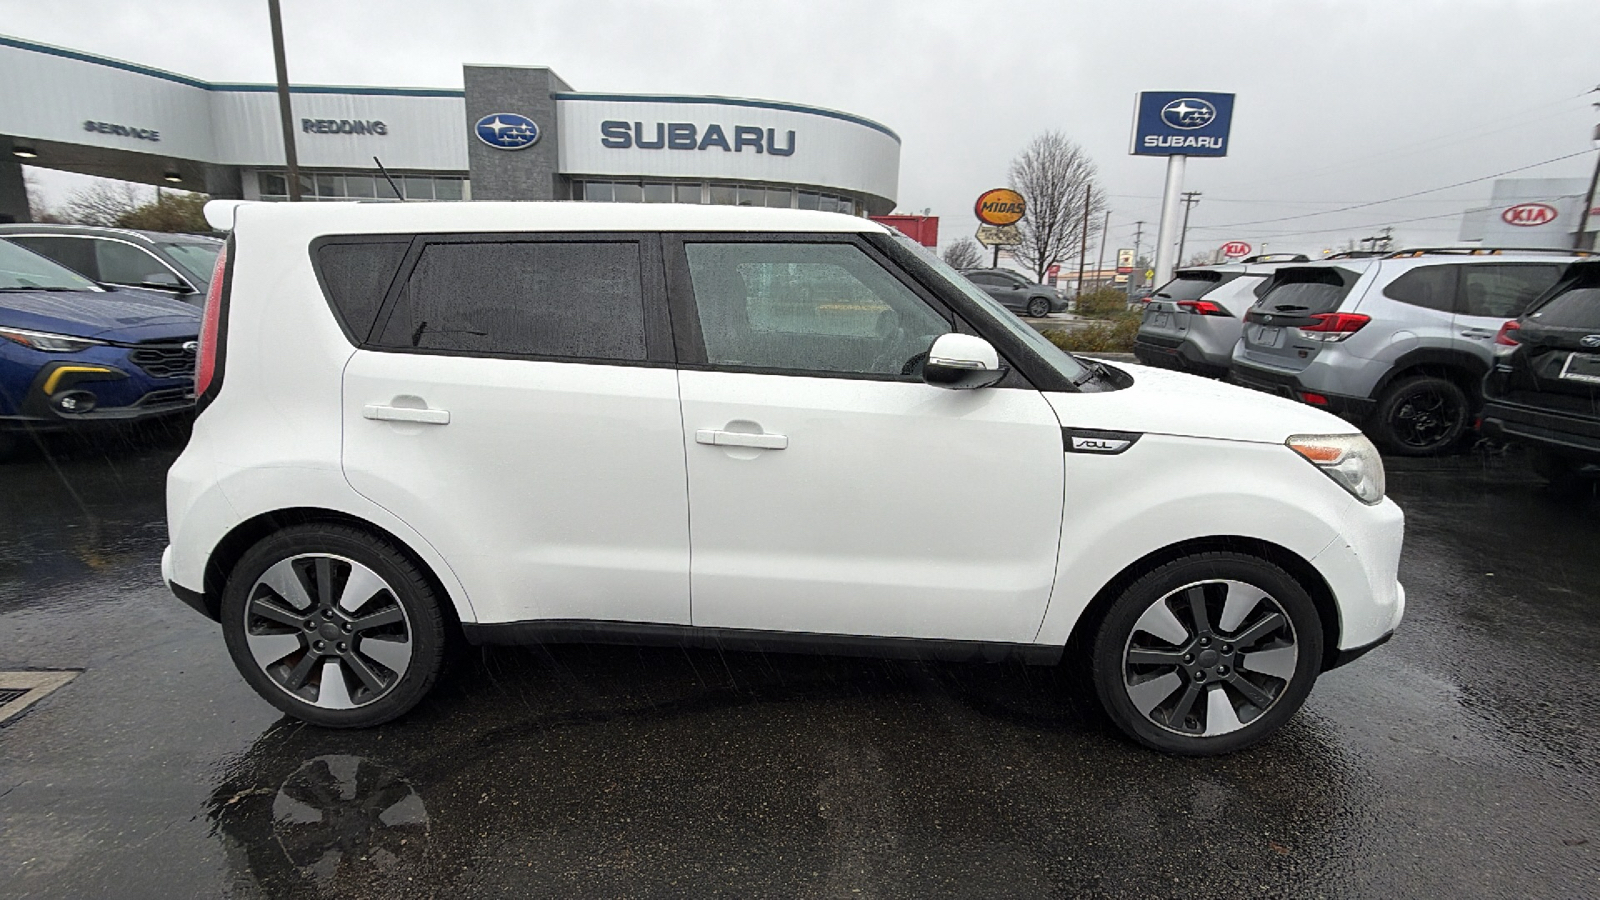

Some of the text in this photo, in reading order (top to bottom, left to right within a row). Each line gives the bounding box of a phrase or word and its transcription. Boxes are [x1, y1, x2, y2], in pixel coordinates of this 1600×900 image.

[83, 120, 160, 142] SERVICE
[301, 118, 388, 135] REDDING
[601, 120, 796, 157] SUBARU
[1144, 135, 1223, 149] SUBARU
[982, 201, 1026, 214] MIDAS
[1512, 208, 1546, 222] KIA
[1226, 244, 1246, 254] KIA
